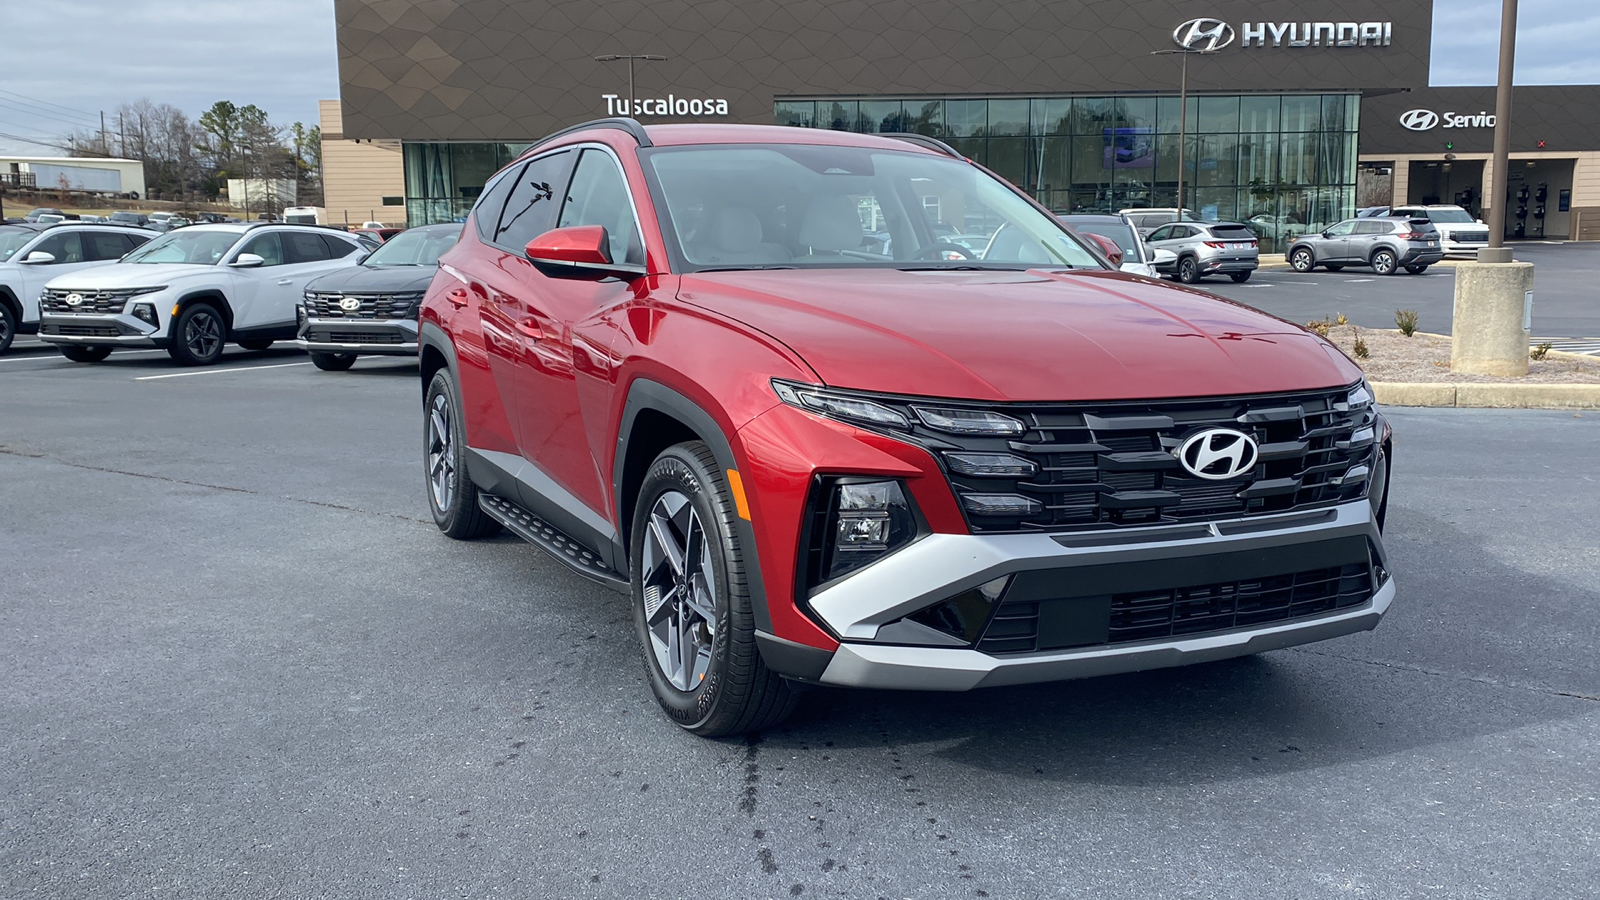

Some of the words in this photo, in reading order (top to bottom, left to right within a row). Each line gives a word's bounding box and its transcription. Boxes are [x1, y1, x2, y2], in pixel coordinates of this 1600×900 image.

[1241, 21, 1392, 48] HYUNDAI
[601, 93, 728, 116] Tuscaloosa
[1442, 110, 1497, 130] Servic
[658, 697, 690, 720] KUMHO
